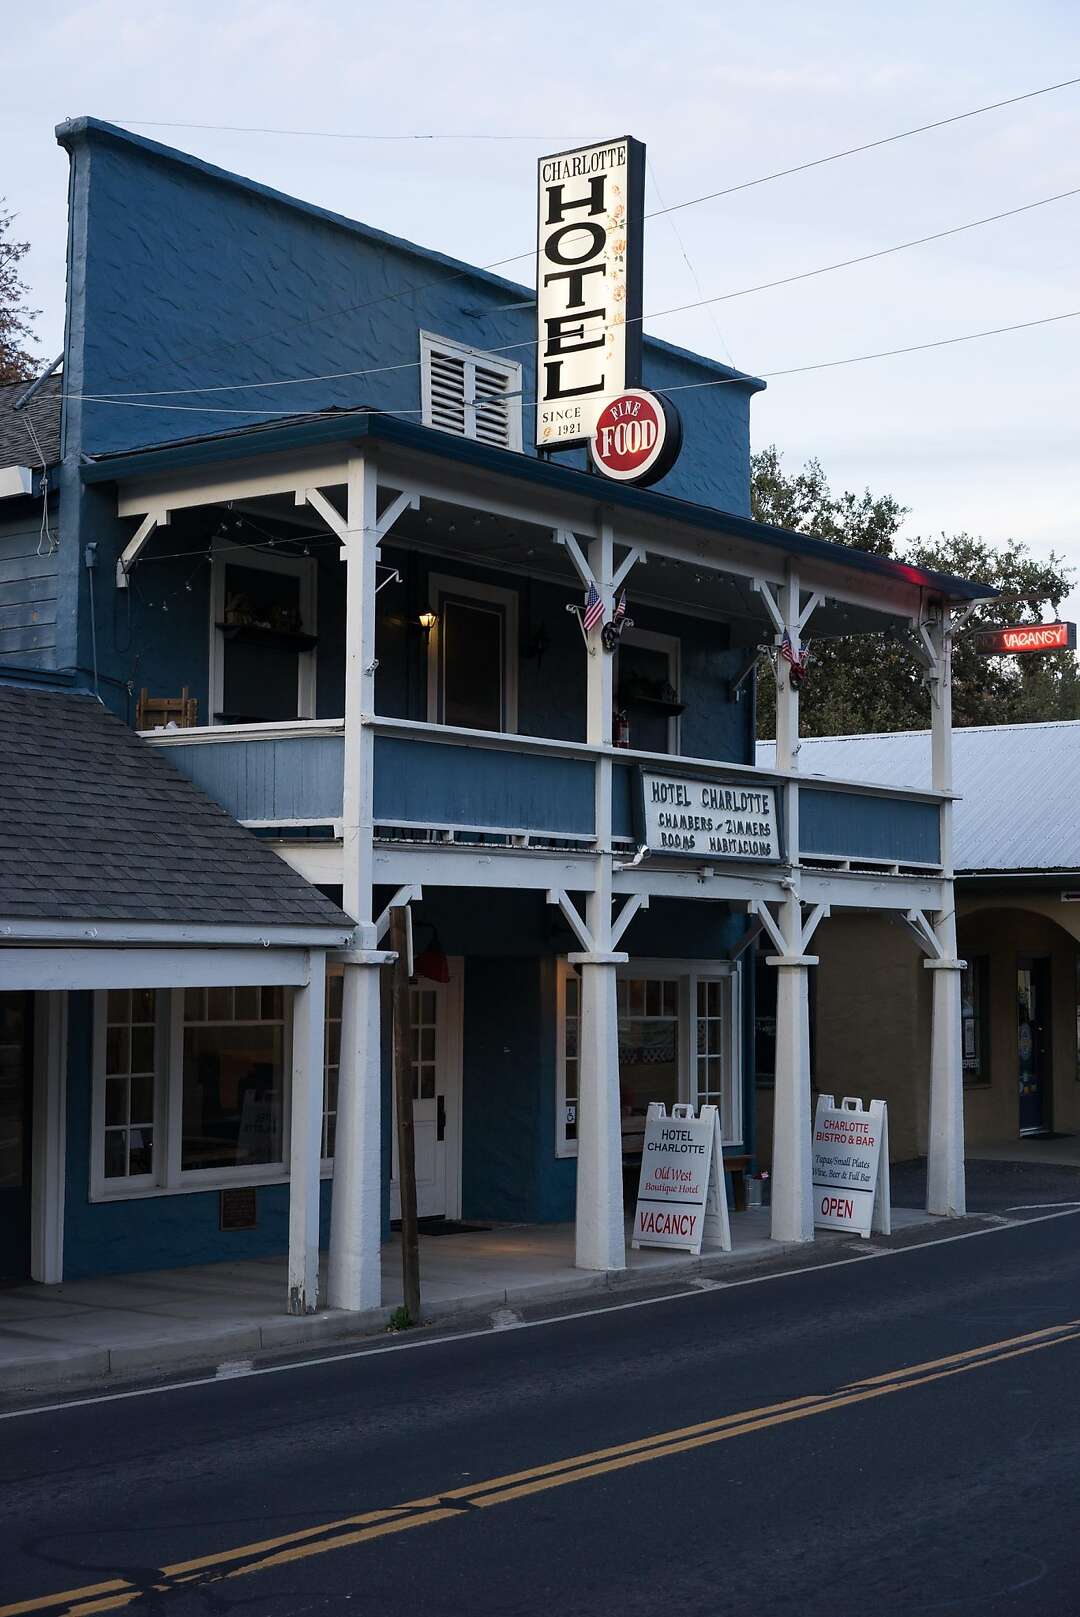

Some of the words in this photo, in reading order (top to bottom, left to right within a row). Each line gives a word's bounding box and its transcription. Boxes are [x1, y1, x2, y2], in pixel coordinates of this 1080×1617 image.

[542, 145, 626, 183] CHARLOTTE
[543, 174, 607, 401] HOTEL
[542, 406, 581, 423] SINCE
[610, 400, 641, 421] FINE
[557, 423, 581, 436] 1921
[600, 419, 656, 458] FOOD
[1003, 629, 1063, 647] VACANCY
[650, 781, 692, 807] HOTEL
[701, 788, 770, 815] CHARLOTTE
[658, 812, 713, 832] CHAMBERS
[725, 819, 771, 837] ZIMMERS
[660, 832, 696, 849] ROOMS
[709, 836, 772, 857] HABITACIONS
[823, 1119, 869, 1134] CHARLOTTE
[661, 1129, 694, 1142] HOTEL
[815, 1131, 847, 1144] BISTRO
[848, 1135, 855, 1145] &
[855, 1136, 875, 1147] BAR
[647, 1142, 705, 1154] CHARLOTTE
[852, 1158, 870, 1169] Plates
[654, 1166, 670, 1180] Old
[672, 1168, 692, 1182] West
[829, 1169, 841, 1179] Beer
[848, 1170, 860, 1181] Full
[860, 1172, 871, 1182] Bar
[645, 1182, 678, 1195] Boutique
[678, 1183, 699, 1194] Hotel
[821, 1197, 854, 1219] OPEN
[640, 1212, 697, 1236] VACANCY
